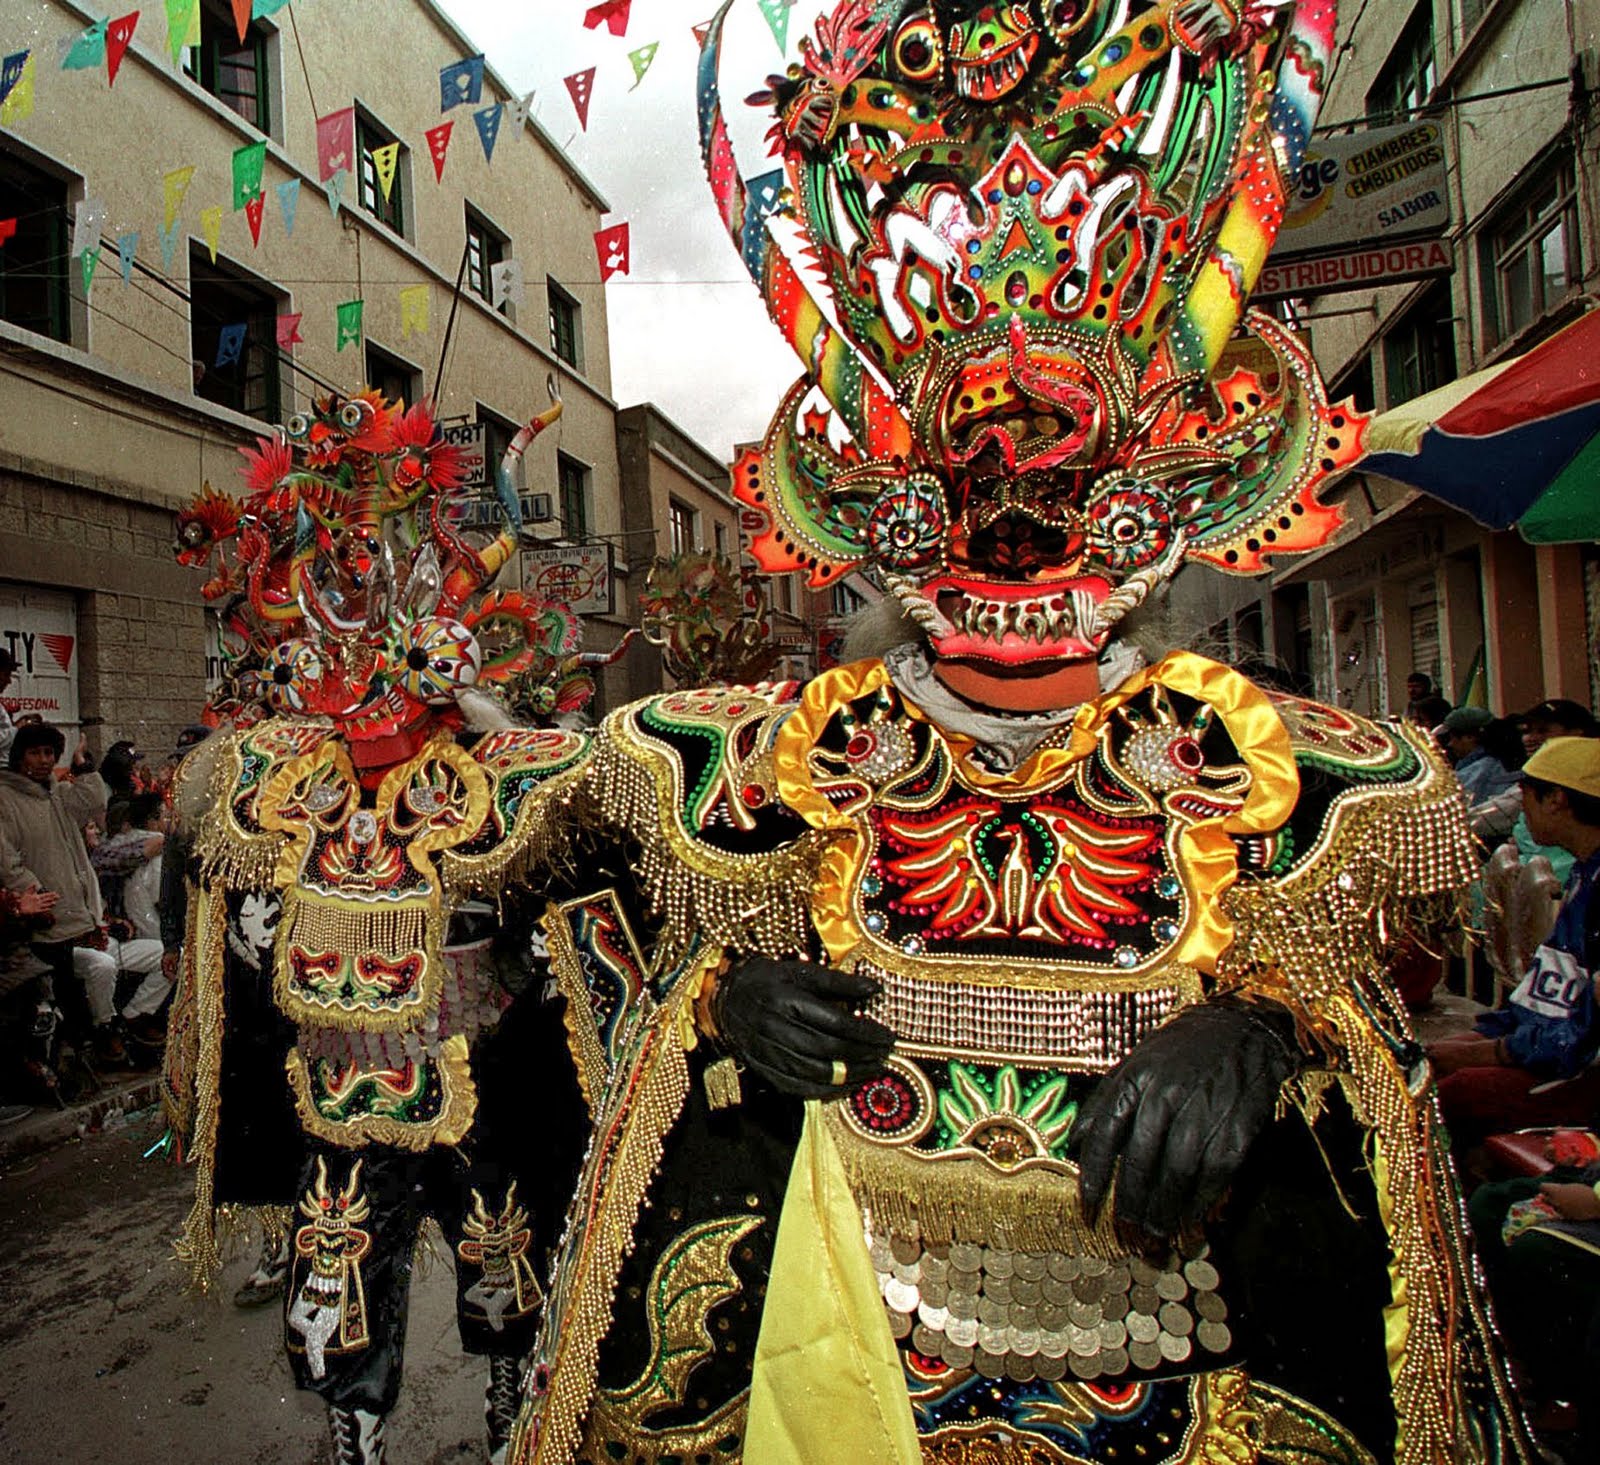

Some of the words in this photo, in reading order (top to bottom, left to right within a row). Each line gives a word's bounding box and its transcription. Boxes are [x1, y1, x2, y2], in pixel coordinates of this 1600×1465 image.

[1353, 125, 1431, 174] FIAMBRES
[1353, 148, 1441, 196] EMBUTIDOS
[1378, 190, 1441, 228] SABOR
